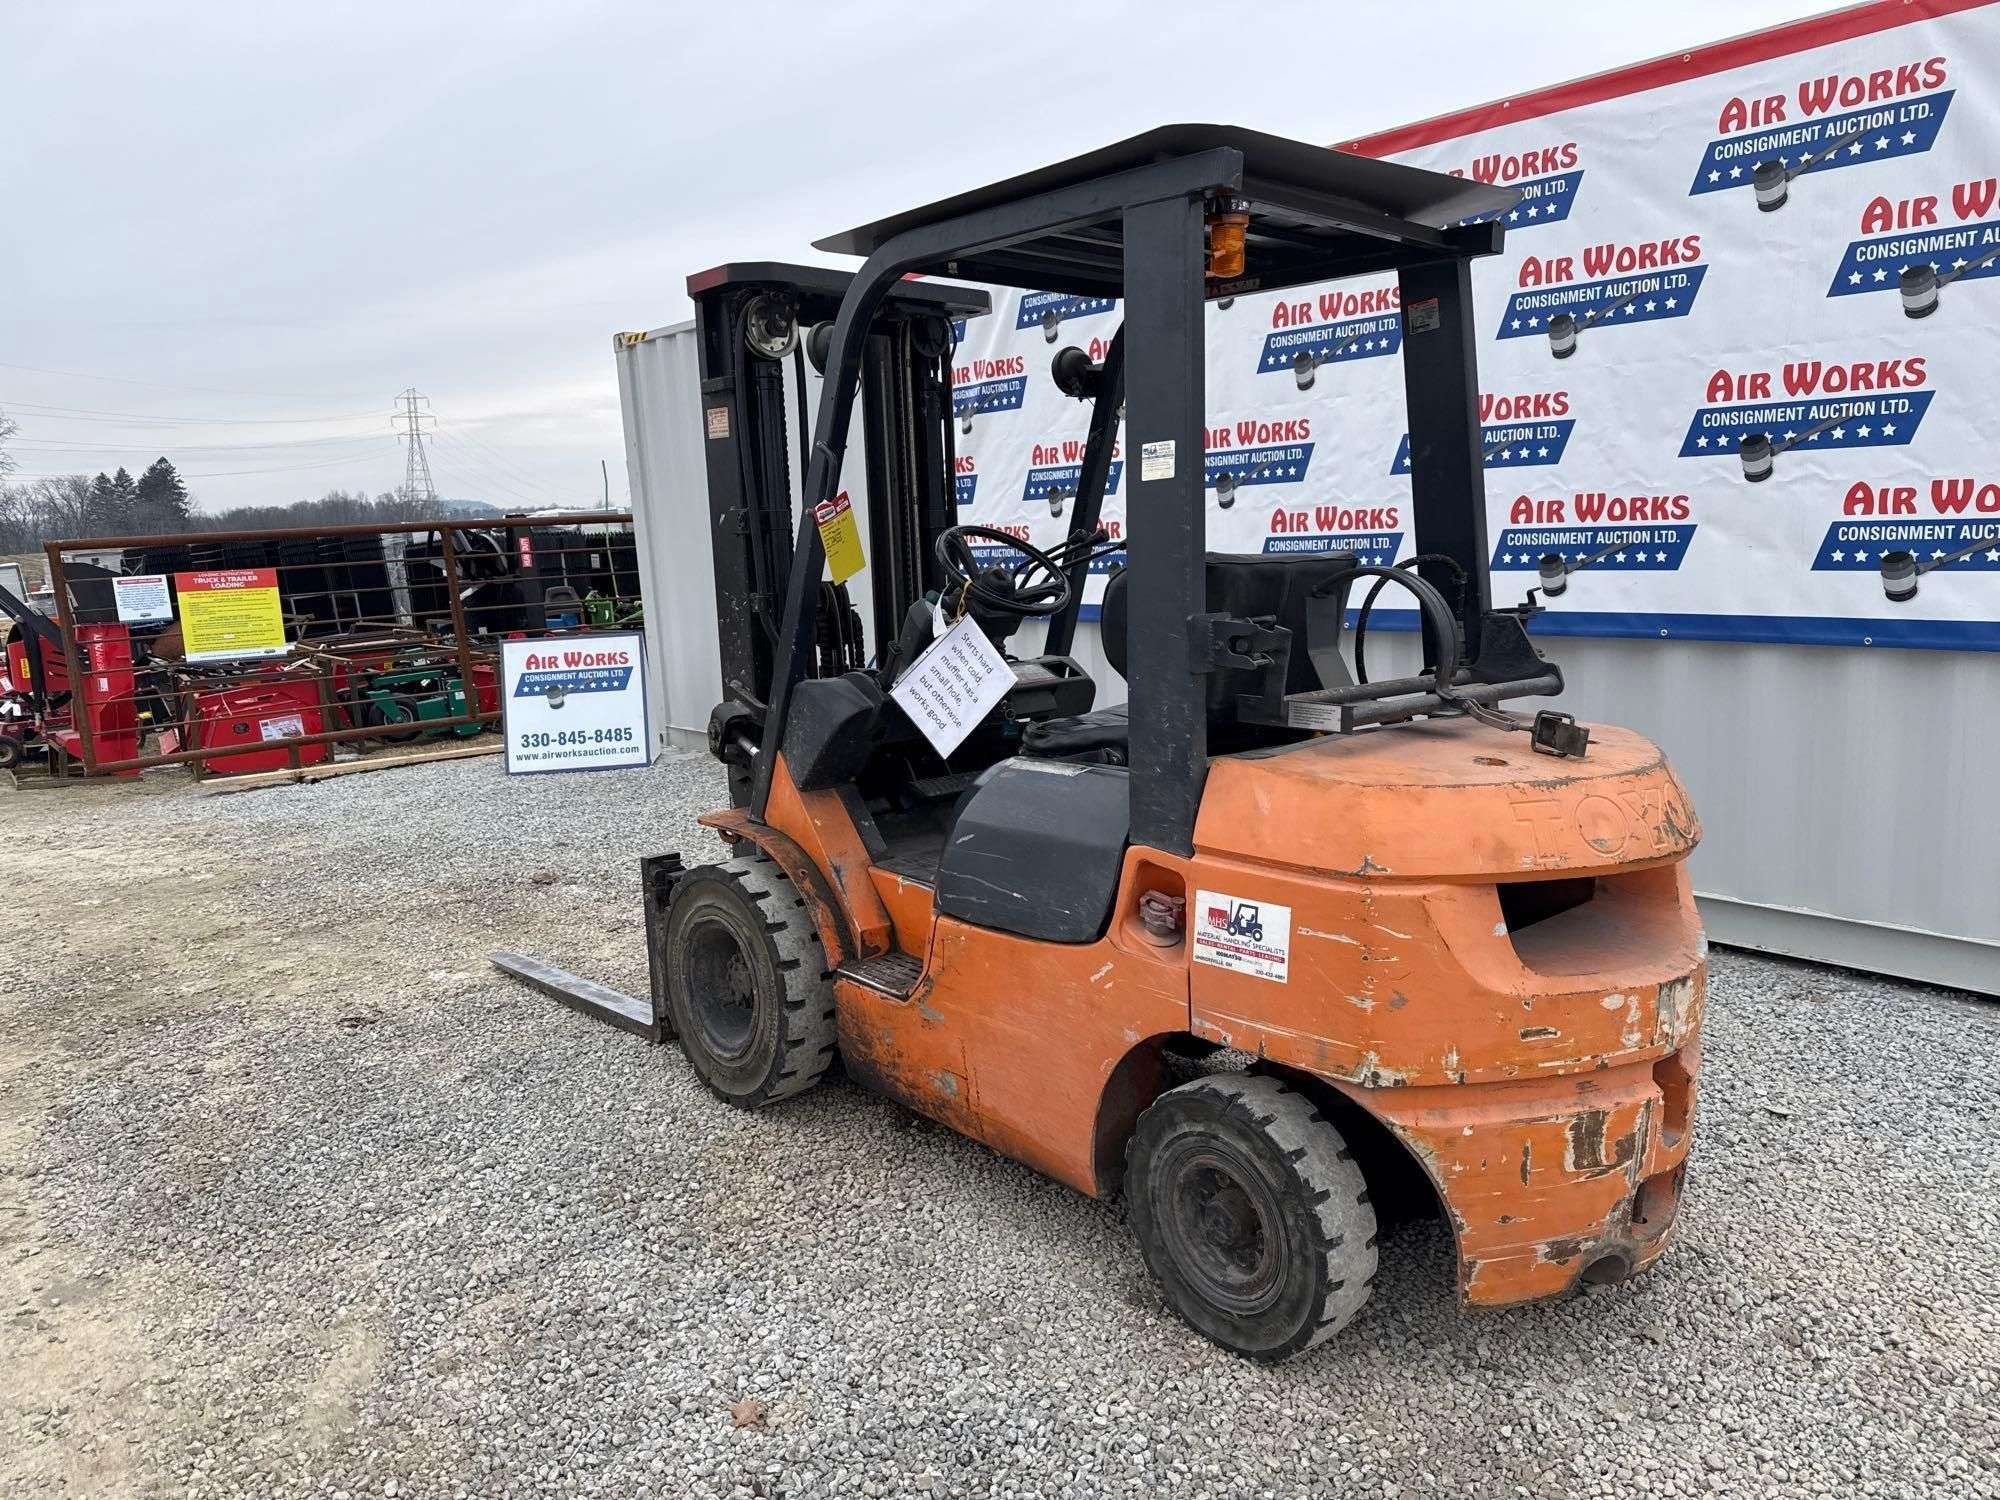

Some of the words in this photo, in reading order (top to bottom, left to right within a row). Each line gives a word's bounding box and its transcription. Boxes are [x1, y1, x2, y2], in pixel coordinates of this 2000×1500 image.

[1719, 94, 1787, 134] AIR
[1799, 56, 1947, 116] WORKS
[1714, 125, 1822, 161] CONSIGNMENT
[1825, 109, 1894, 139] AUCTION
[1900, 102, 1934, 123] LTD.
[1472, 142, 1578, 185] WORKS
[1545, 179, 1569, 196] LTD.
[1861, 196, 1938, 235] AIR
[1856, 230, 1978, 262] CONSIGNMENT
[1519, 256, 1574, 287] AIR
[1583, 235, 1700, 278] WORKS
[1516, 286, 1603, 311] CONSIGNMENT
[1605, 279, 1660, 298] AUCTION
[1664, 273, 1691, 290] LTD.
[1272, 301, 1313, 329] AIR
[1319, 286, 1400, 321] WORKS
[1270, 328, 1332, 349] CONSIGNMENT
[1335, 320, 1375, 339] AUCTION
[1378, 317, 1399, 332] LTD.
[1088, 337, 1113, 361] AI
[973, 355, 1024, 381] WORKS
[1706, 369, 1771, 403] AIR
[1783, 357, 1927, 397] WORKS
[1702, 406, 1805, 428] CONSIGNMENT
[1809, 401, 1876, 420] AUCTION
[1881, 399, 1914, 414] LTD.
[1237, 418, 1311, 446] WORKS
[1484, 427, 1533, 443] AUCTION
[1537, 426, 1561, 439] LTD.
[1032, 444, 1059, 466] AIR
[1205, 452, 1250, 467] NSIGNMENT
[1251, 449, 1285, 463] AUCTION
[1287, 448, 1305, 460] LTD.
[1031, 470, 1074, 481] CONSIGNMENT
[1510, 495, 1565, 524] AIR
[1574, 493, 1690, 523] WORKS
[1843, 481, 1917, 516] AIR
[1270, 507, 1309, 533] AIR
[1315, 506, 1399, 532] WORKS
[1838, 525, 1955, 541] CONSIGNMENT
[1960, 524, 2000, 540] AUCT
[1269, 539, 1329, 552] CONSIGNMENT
[1331, 537, 1370, 550] AUCTION
[1373, 537, 1392, 549] LTD.
[1507, 531, 1593, 546] CONSIGNMENT
[1596, 530, 1650, 544] AUCTION
[1654, 530, 1680, 543] LTD.
[210, 581, 246, 589] LOADING
[228, 575, 258, 583] TRAILER
[525, 653, 560, 670] AIR
[563, 651, 629, 668] WORKS
[951, 644, 969, 667] when
[967, 665, 983, 687] cold,
[961, 632, 980, 656] Starts
[977, 654, 994, 675] hard
[524, 672, 577, 683] CONSIGNMENT
[578, 671, 609, 680] AUCTION
[610, 669, 626, 678] LTD.
[929, 665, 950, 689] small
[947, 685, 962, 707] hole,
[940, 655, 964, 683] muffler
[963, 681, 975, 700] has
[909, 686, 927, 711] works
[919, 675, 933, 692] but
[931, 690, 962, 729] otherwise
[520, 727, 633, 749] 330-845-8485
[516, 747, 640, 762] www.airworksauction.com
[1208, 915, 1228, 929] MHS
[1197, 931, 1221, 941] MATERIAL
[1223, 936, 1251, 948] HANDLING
[1252, 942, 1285, 955] SPECIALISTS
